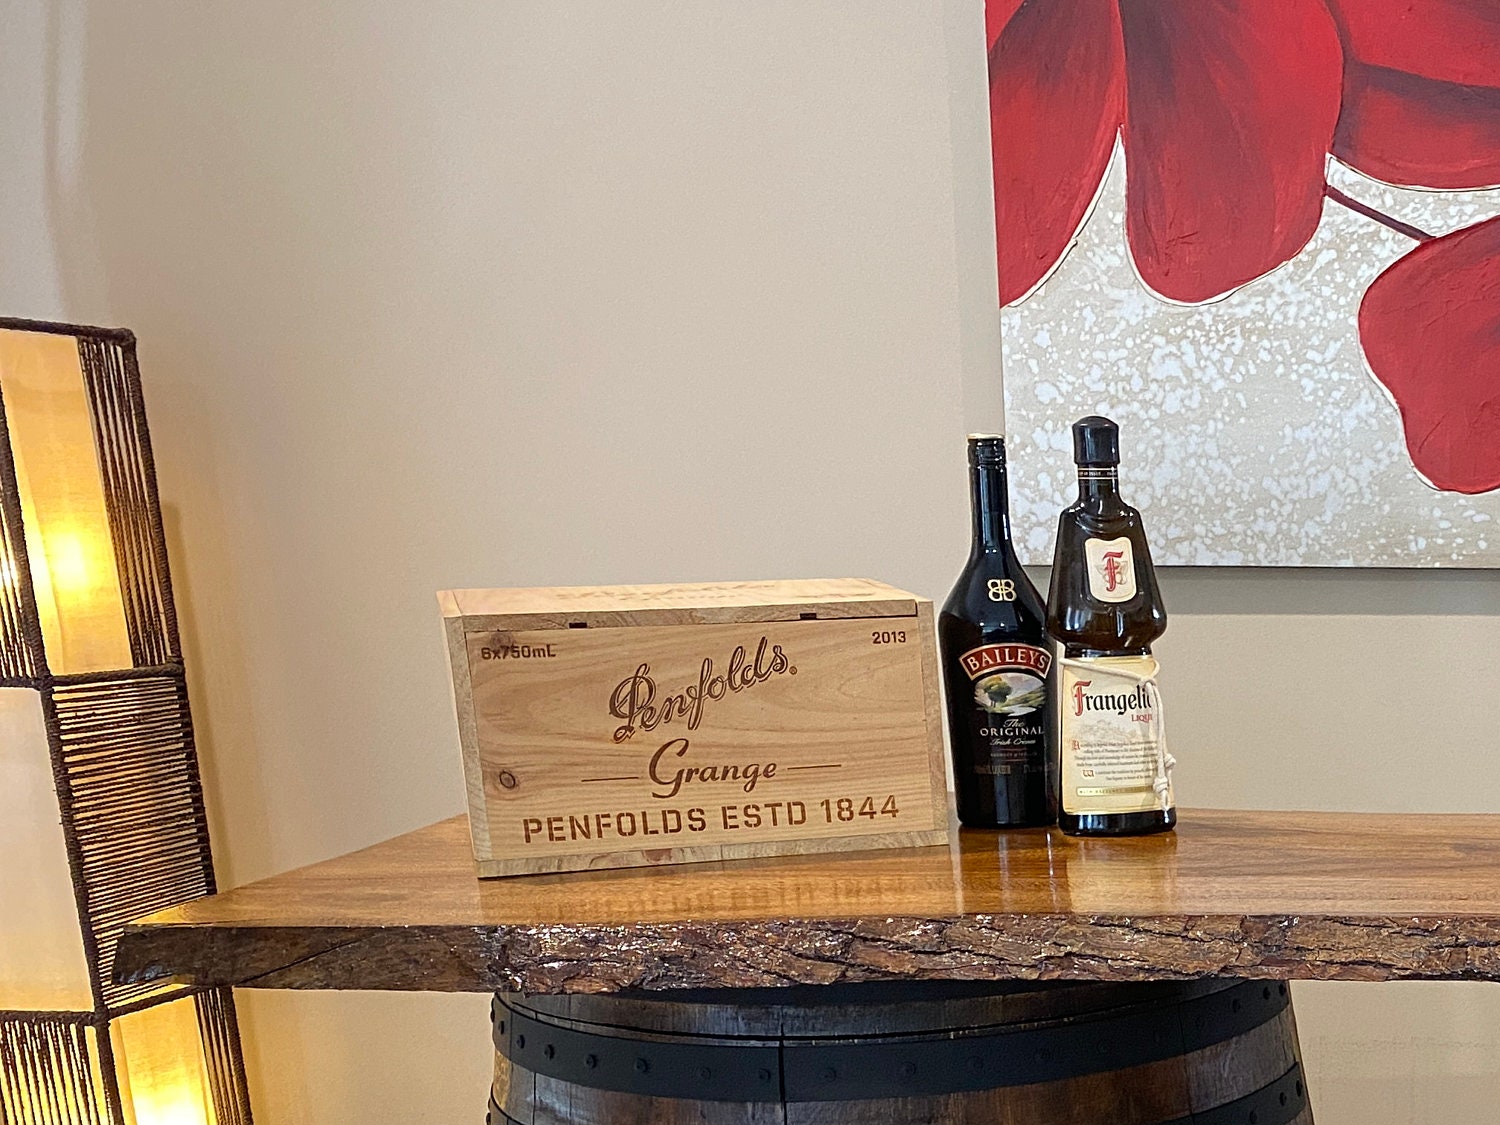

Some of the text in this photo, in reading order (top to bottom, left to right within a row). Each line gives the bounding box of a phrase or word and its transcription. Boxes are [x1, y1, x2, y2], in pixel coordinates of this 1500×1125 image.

[871, 630, 908, 645] 2013
[480, 643, 557, 661] 6x750mL
[966, 647, 1048, 672] BAILEYS
[979, 725, 1046, 737] ORIGINAL
[648, 737, 778, 799] Grange
[522, 794, 901, 844] PENFOLDS ESTD 1844
